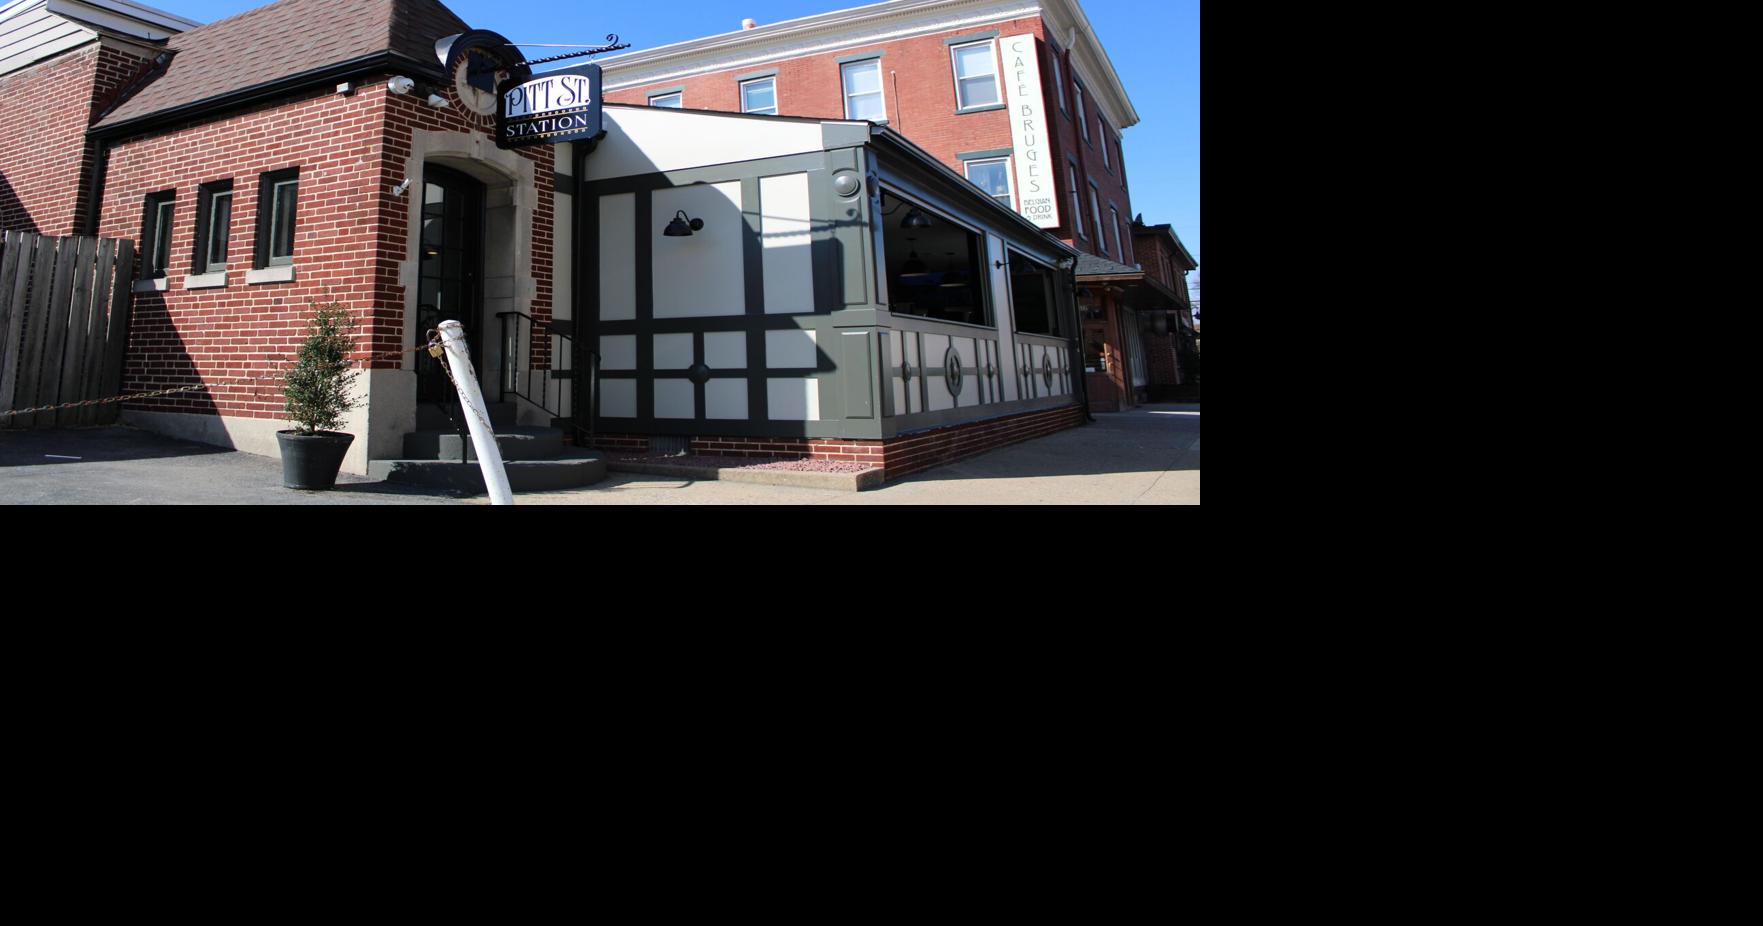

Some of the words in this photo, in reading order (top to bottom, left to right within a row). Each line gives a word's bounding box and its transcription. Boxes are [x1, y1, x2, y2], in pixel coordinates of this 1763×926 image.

[505, 79, 554, 116] PITT
[557, 76, 590, 106] ST.
[506, 114, 587, 137] STATION
[1021, 104, 1040, 193] BRUGES
[1023, 198, 1051, 206] BELGIAN
[1024, 205, 1052, 215] FOOD
